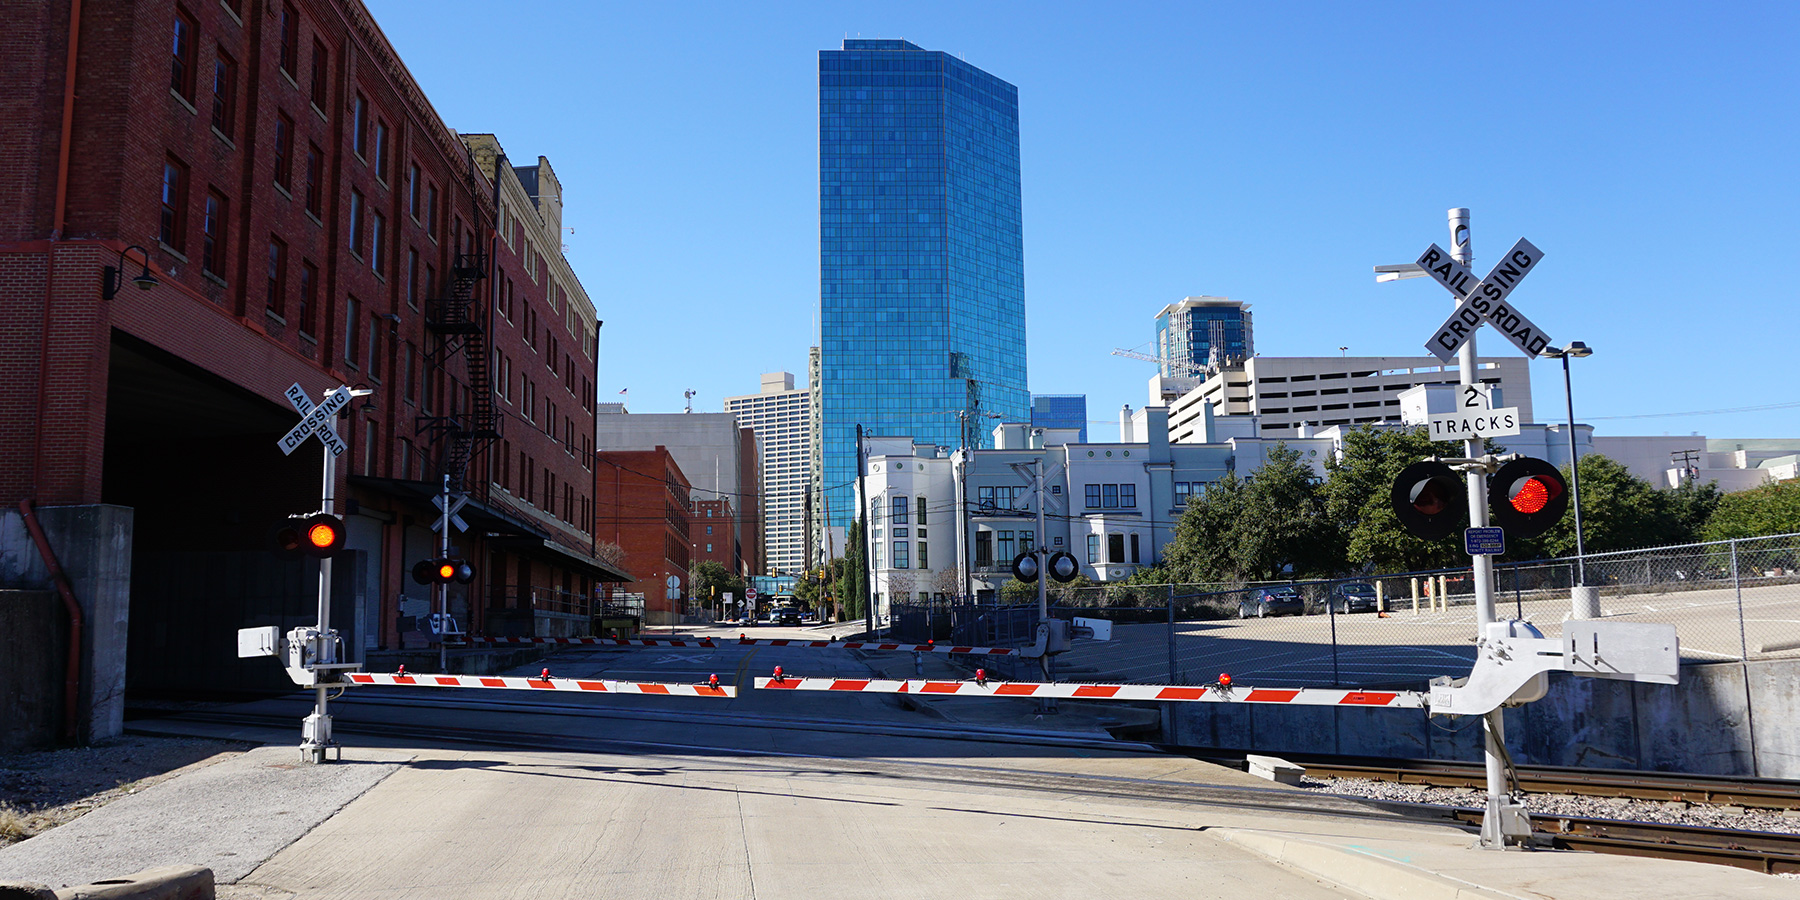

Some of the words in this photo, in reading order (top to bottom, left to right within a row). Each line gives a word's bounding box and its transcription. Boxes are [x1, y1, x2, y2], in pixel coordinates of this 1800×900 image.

[1421, 248, 1469, 297] RAIL
[1489, 304, 1547, 356] ROAD
[1437, 250, 1532, 351] CROSSING
[284, 392, 345, 448] CROSSING
[287, 386, 311, 416] RAIL
[316, 423, 344, 456] ROAD
[1433, 415, 1514, 434] TRACKS
[1464, 388, 1479, 407] 2
